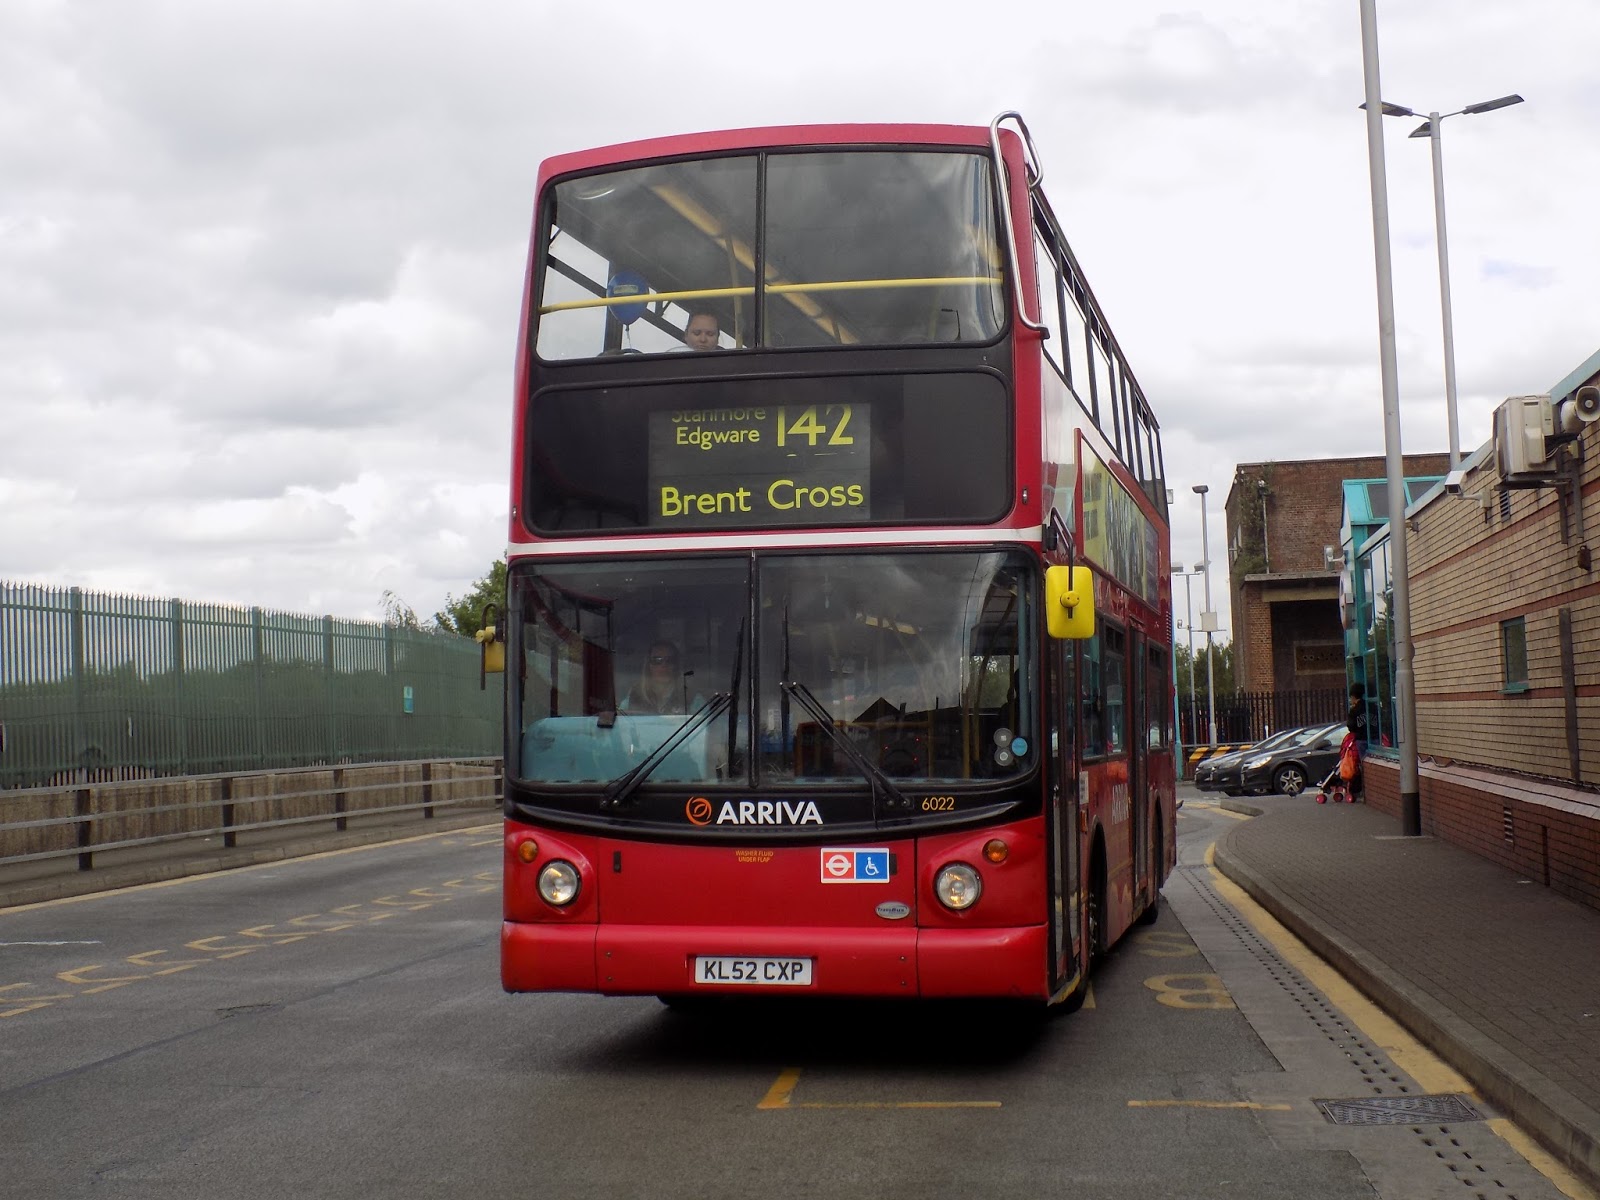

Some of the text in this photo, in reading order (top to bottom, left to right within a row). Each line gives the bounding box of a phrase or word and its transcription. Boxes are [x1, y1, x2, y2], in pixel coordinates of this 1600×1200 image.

[777, 403, 854, 447] 142
[676, 426, 760, 450] Edgware
[661, 479, 865, 517] Brent Cross
[716, 800, 824, 825] ARRIVA
[921, 796, 955, 811] 6022
[704, 960, 803, 980] KL52 CXP
